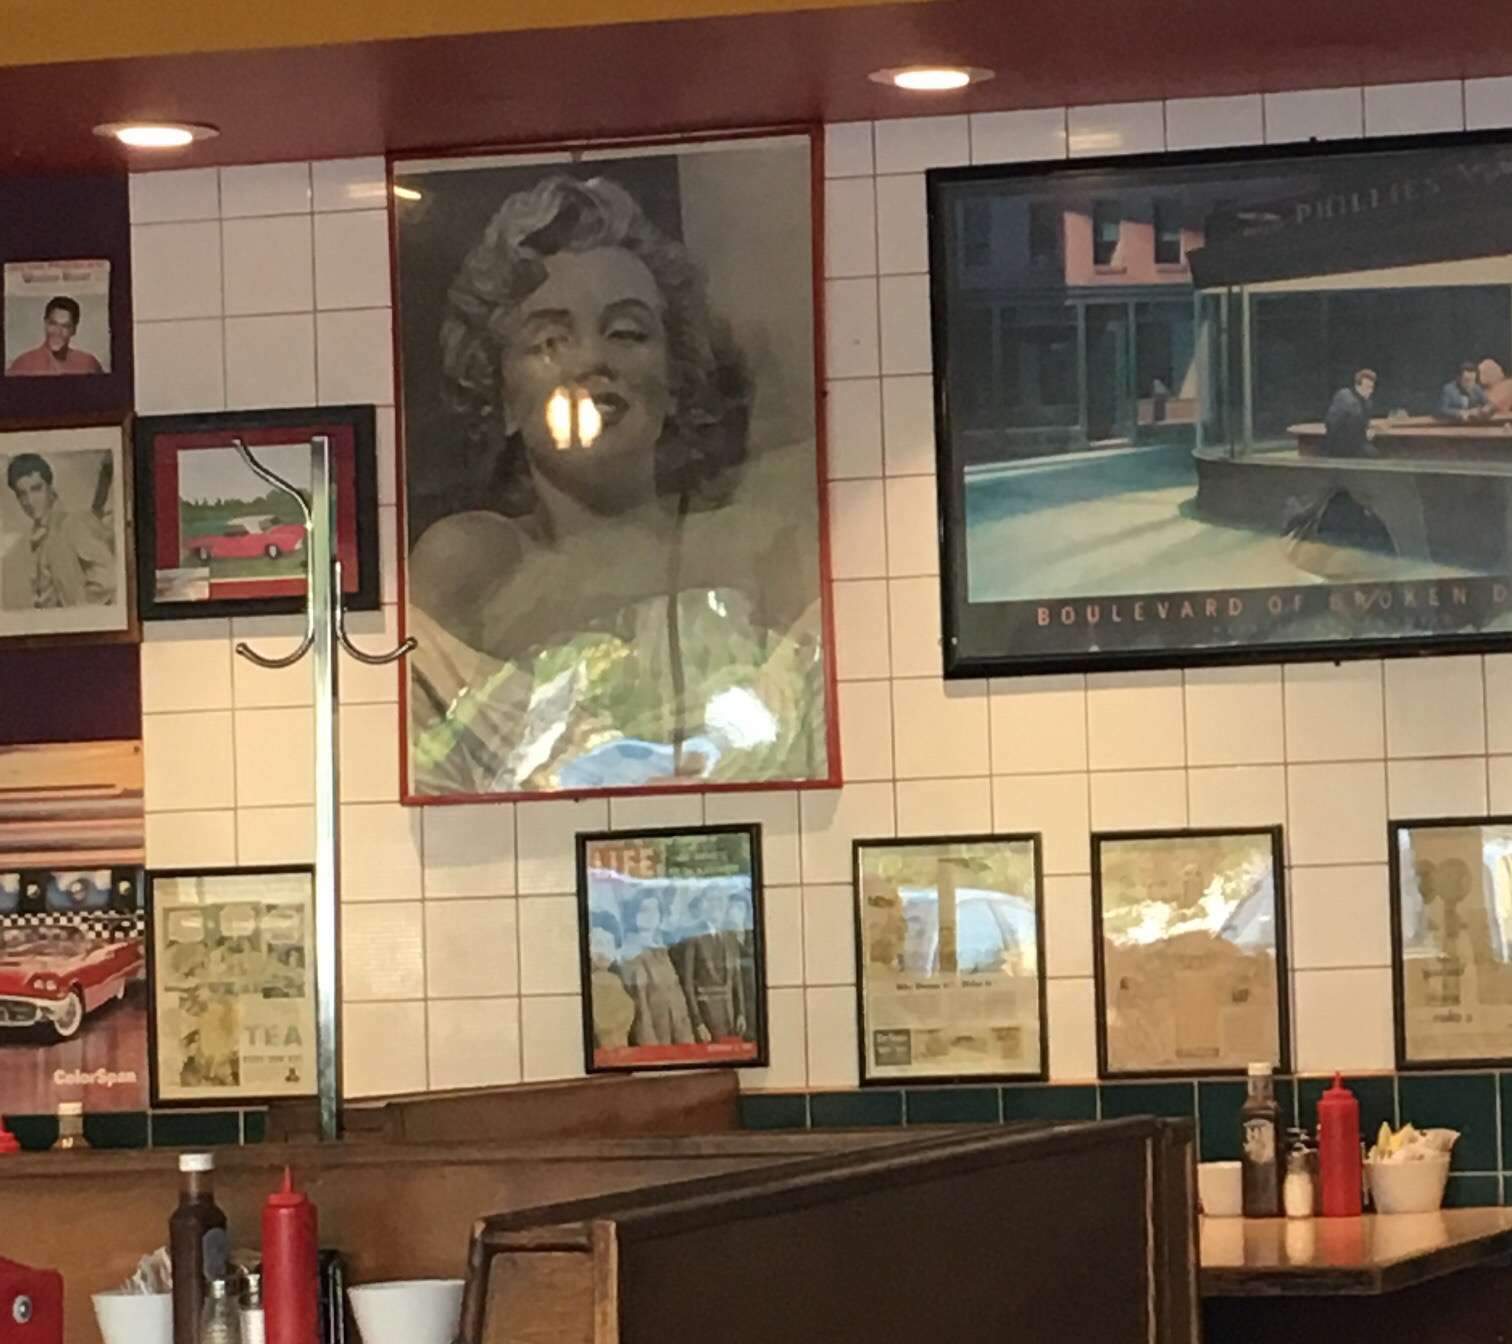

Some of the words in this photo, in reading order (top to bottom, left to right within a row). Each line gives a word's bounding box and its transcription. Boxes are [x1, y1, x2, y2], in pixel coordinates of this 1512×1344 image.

[1037, 596, 1243, 627] BOULEVARD
[1268, 592, 1303, 613] OF
[244, 1024, 303, 1047] TEA
